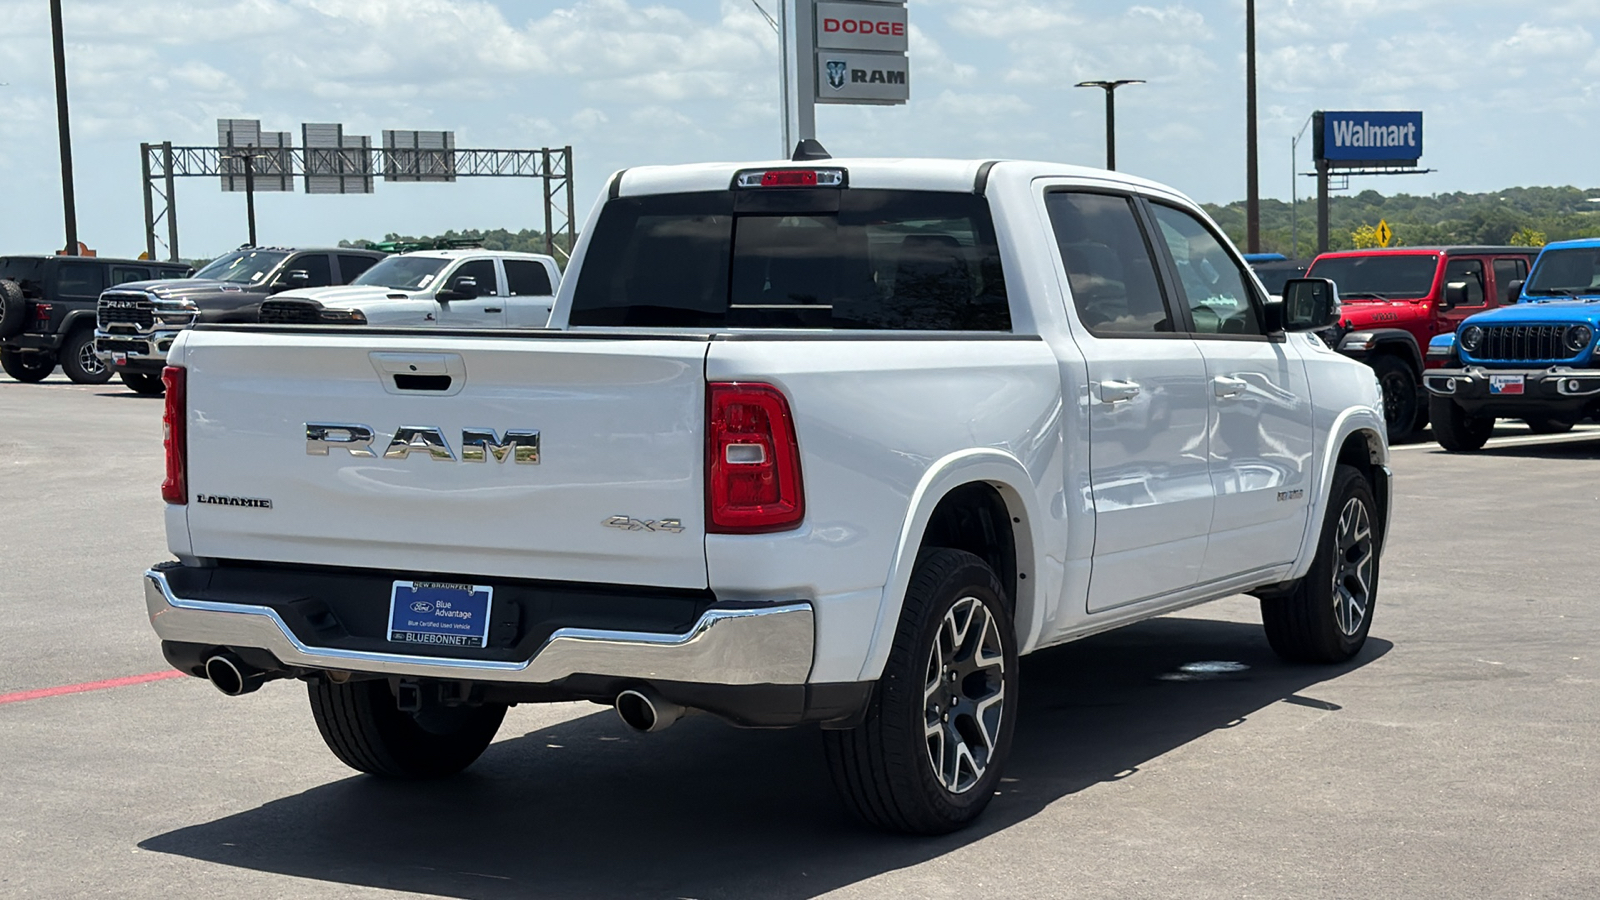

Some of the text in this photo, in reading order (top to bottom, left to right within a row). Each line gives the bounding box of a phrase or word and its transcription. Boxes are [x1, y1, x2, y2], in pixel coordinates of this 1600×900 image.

[824, 18, 904, 36] DODGE
[851, 69, 905, 84] RAM
[1333, 120, 1415, 147] Walmart
[305, 422, 541, 465] RAM
[197, 493, 273, 509] LARAMIE
[431, 582, 472, 591] BRAUNFELS
[436, 600, 452, 609] Blue
[435, 609, 472, 620] Advantage
[405, 632, 467, 645] BLUEBONNET
